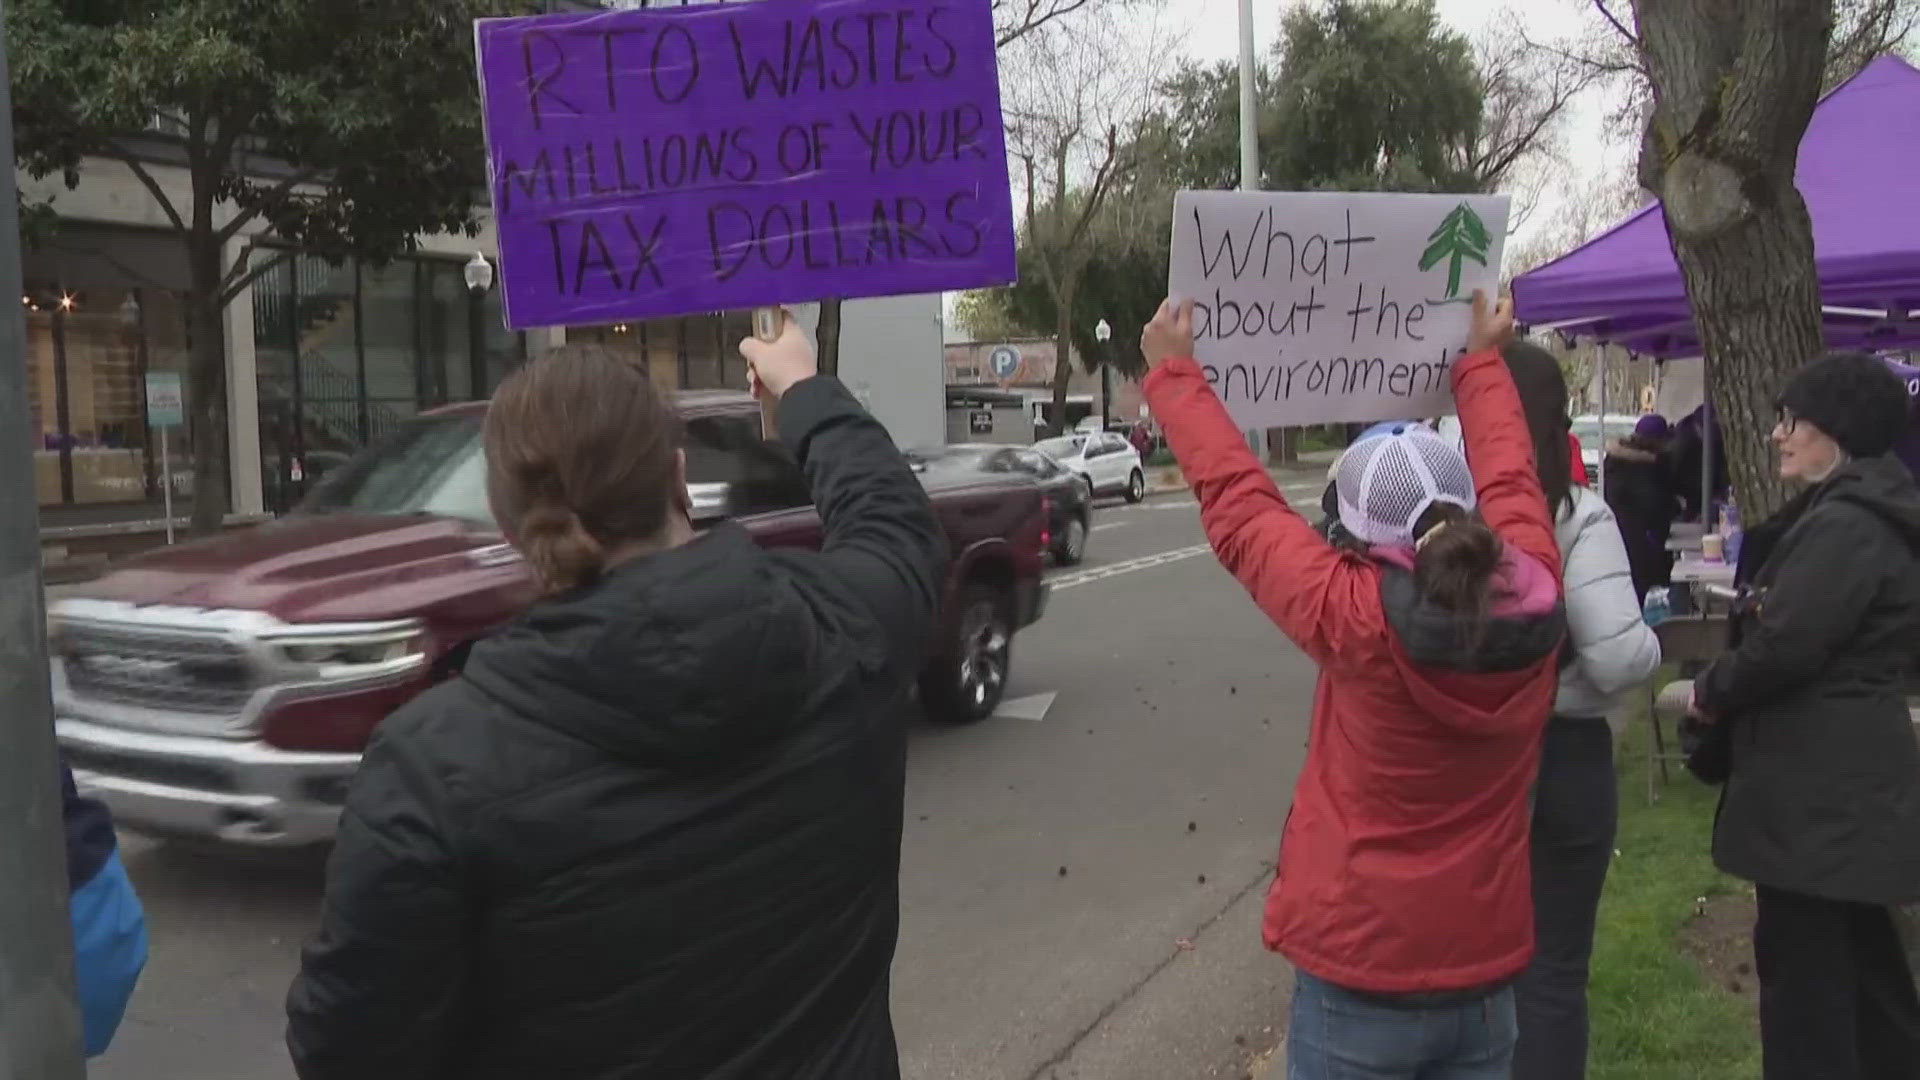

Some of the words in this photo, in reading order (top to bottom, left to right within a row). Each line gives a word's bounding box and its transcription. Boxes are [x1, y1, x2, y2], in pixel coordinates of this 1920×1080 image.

[521, 24, 699, 130] RTO
[729, 7, 957, 101] WASTES
[502, 125, 758, 214] MILLIONS
[777, 123, 835, 175] OF
[848, 103, 988, 174] YOUR
[541, 213, 668, 294] TAX
[706, 191, 983, 282] DOLLARS
[1193, 205, 1376, 285] What
[1193, 285, 1327, 342] about
[1347, 282, 1427, 344] the
[995, 350, 1012, 375] P
[1202, 348, 1467, 404] environment
